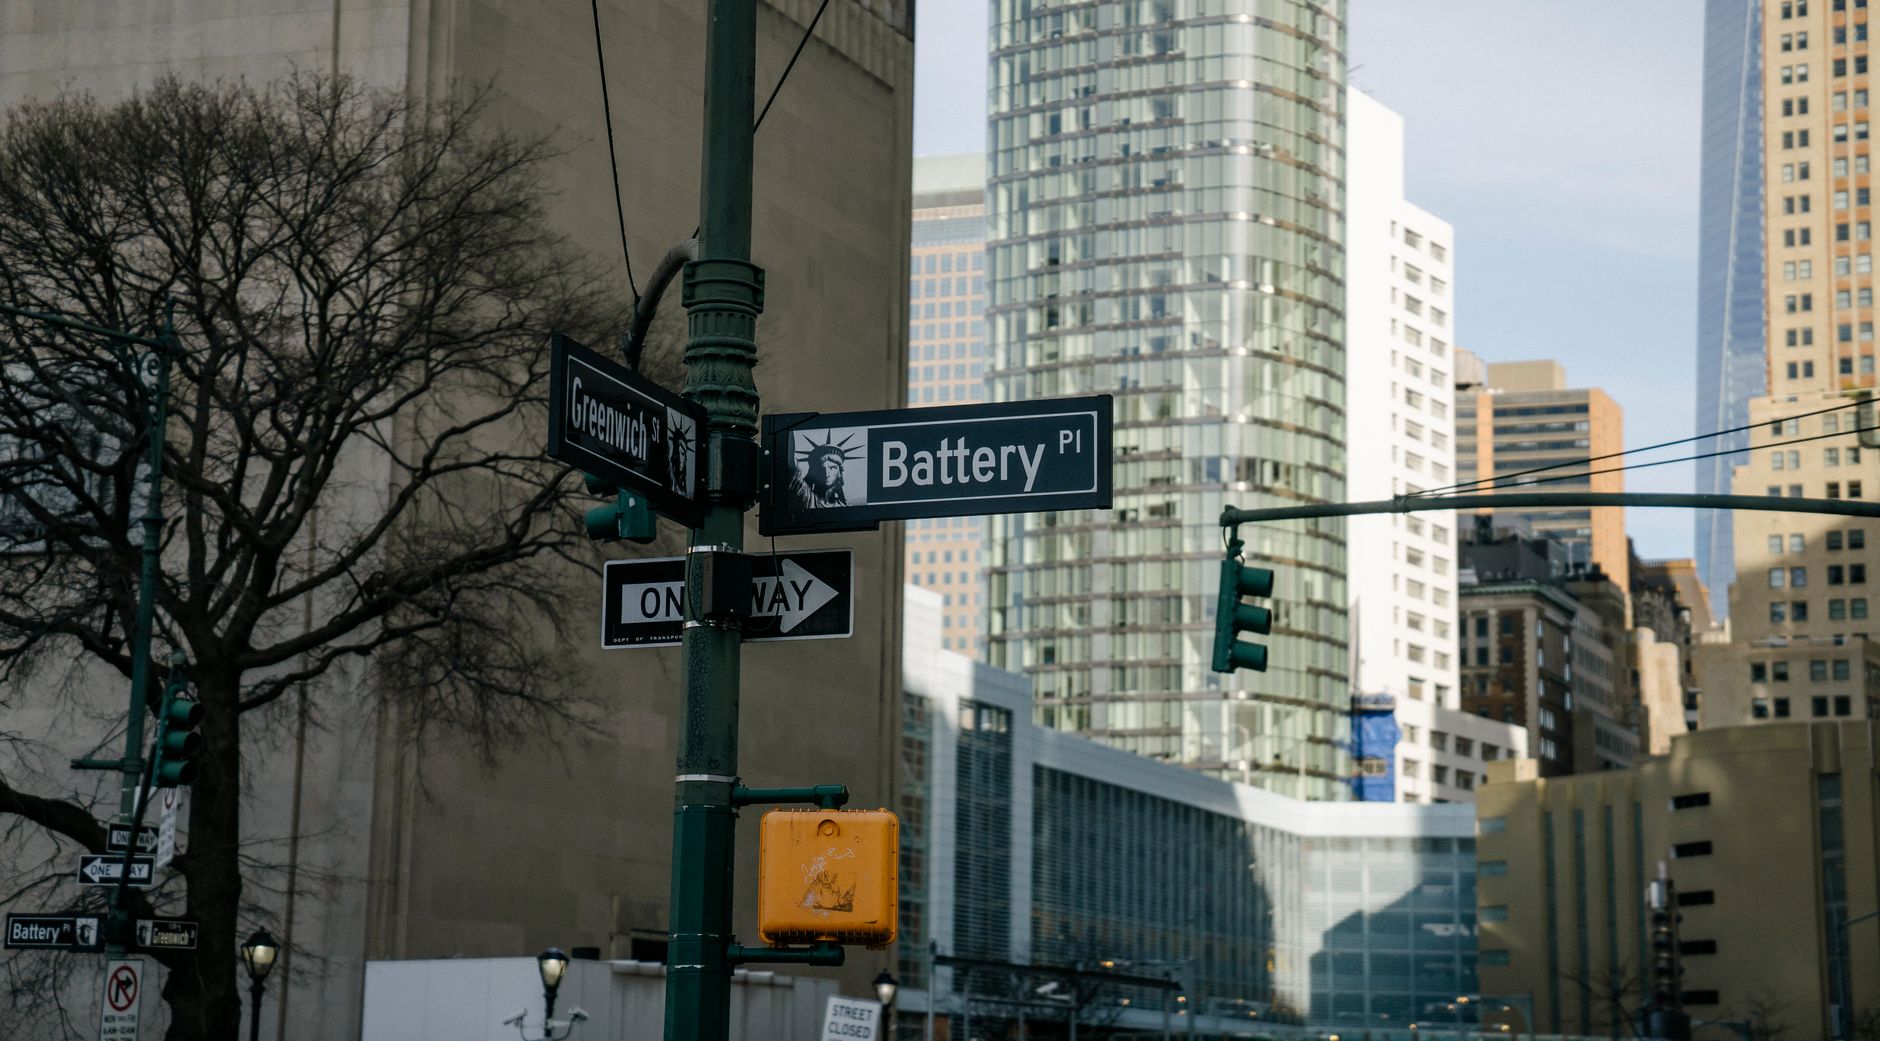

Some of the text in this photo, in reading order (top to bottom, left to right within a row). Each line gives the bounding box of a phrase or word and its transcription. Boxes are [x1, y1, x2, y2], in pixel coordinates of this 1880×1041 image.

[571, 375, 661, 461] Greenwich St
[882, 429, 1081, 492] Battery Pl
[640, 586, 685, 619] ON
[90, 865, 145, 876] ONE AY
[12, 922, 60, 944] Battery
[153, 927, 189, 945] Greenwich
[831, 1004, 873, 1022] STREET
[828, 1021, 871, 1039] CLOSED
